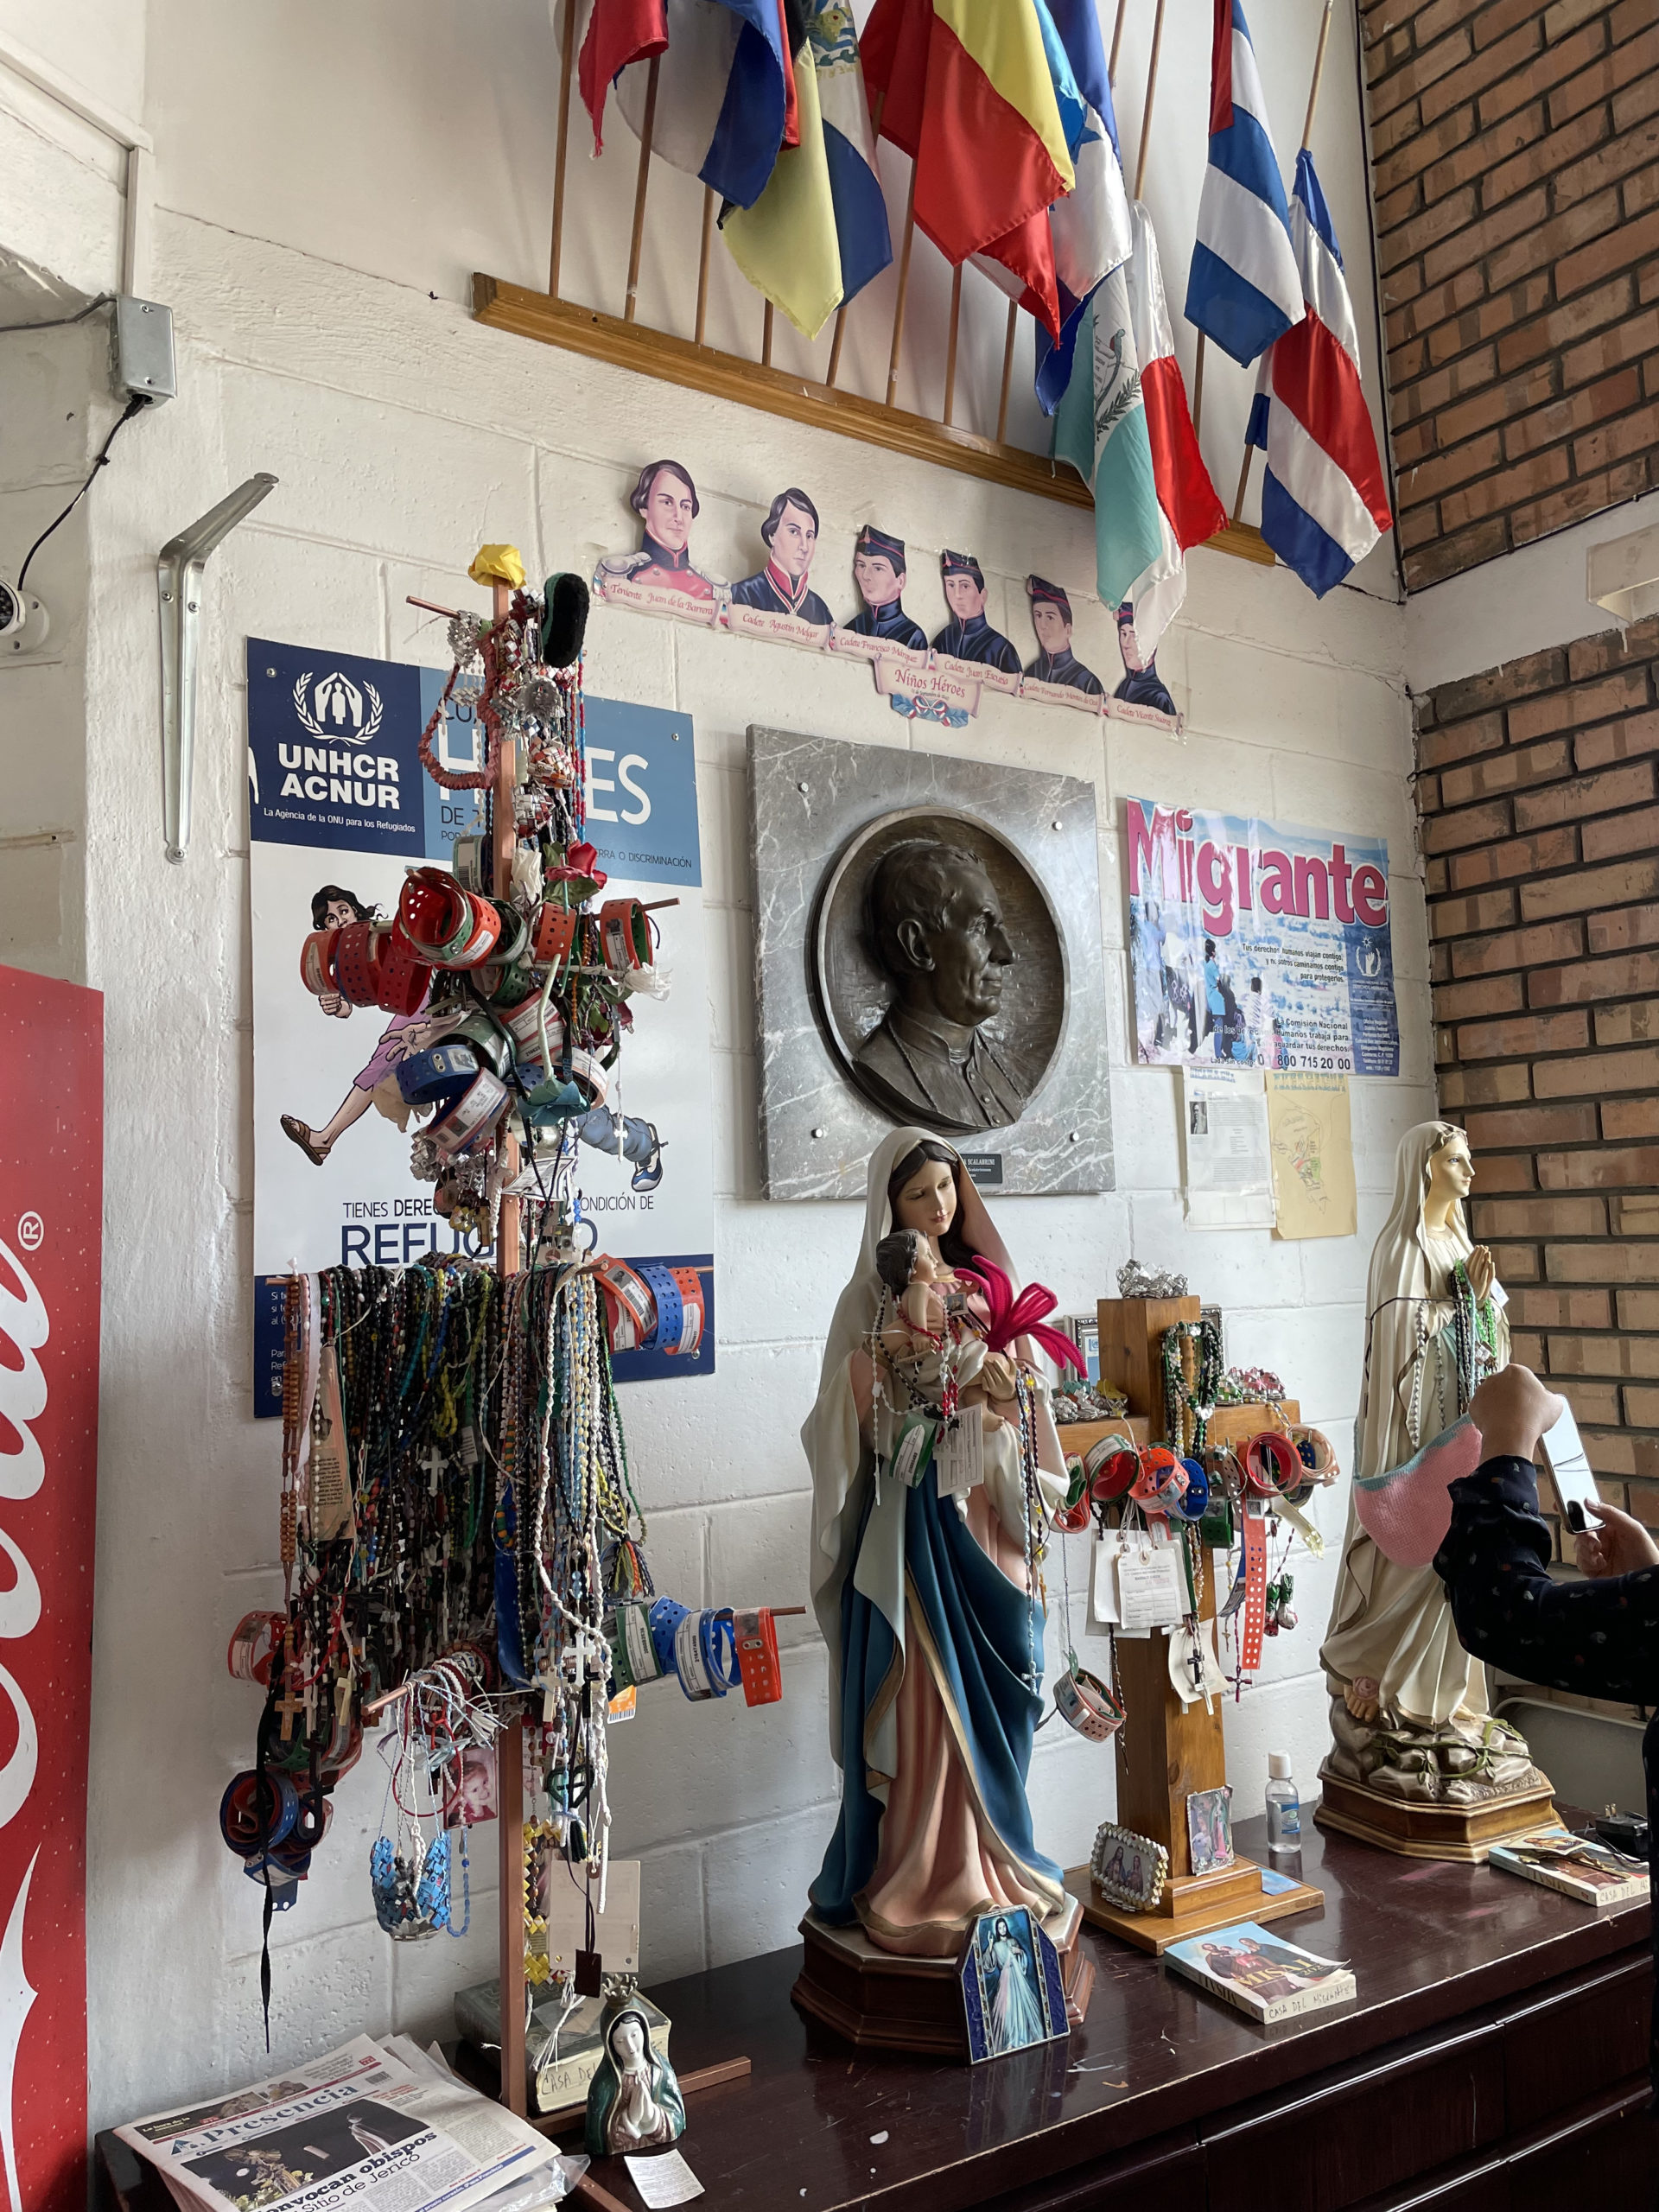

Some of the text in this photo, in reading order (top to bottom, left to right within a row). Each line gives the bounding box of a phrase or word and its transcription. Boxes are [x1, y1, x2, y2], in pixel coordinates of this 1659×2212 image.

[610, 583, 713, 615] Teniente Juan de la Barrera
[743, 613, 765, 627] Cadete
[797, 626, 819, 641] Melgar
[840, 637, 861, 648] Cadete
[861, 640, 891, 653] Francisco
[894, 669, 965, 698] Niños Héroes
[944, 661, 1008, 685] Cadete Juan Escutia
[1117, 705, 1135, 717] Cadete
[1135, 709, 1154, 721] Vicente
[278, 743, 400, 782] UNHCR
[280, 773, 400, 810] ACNUR
[264, 808, 416, 833] La Agencia de la ONU para los Refugiados
[441, 805, 464, 825] DE
[619, 851, 626, 861] O
[628, 853, 692, 868] DISCRIMINACIÓN
[1126, 797, 1389, 937] Migrante
[1243, 943, 1253, 951] Tus
[1254, 945, 1280, 955] derechos
[1282, 947, 1304, 957] humanos
[1305, 950, 1322, 959] viajan
[1294, 960, 1324, 969] caminamos
[1325, 963, 1344, 972] contigo
[1300, 972, 1313, 981] para
[1212, 1024, 1224, 1033] de
[1224, 1025, 1236, 1034] los
[1276, 1028, 1307, 1039] Humanos
[1309, 1032, 1332, 1041] trabaja
[1333, 1033, 1349, 1042] para
[1319, 1020, 1348, 1030] Nacional
[1277, 1054, 1296, 1067] 800
[1300, 1055, 1318, 1068] 715
[1320, 1056, 1333, 1070] 20
[1338, 1058, 1351, 1071] 00
[343, 1202, 389, 1218] TIENES
[580, 1192, 636, 1211] ONDICIÓN
[640, 1195, 654, 1210] DE
[1233, 1959, 1314, 1987] MISAL
[1268, 2005, 1287, 2018] CASA
[1292, 1998, 1306, 2012] DEL
[541, 2071, 571, 2095] CASA
[200, 2085, 359, 2143] Presencia
[257, 2132, 437, 2212] nvocan obispos
[302, 2151, 421, 2212] Sitio de Jericó
